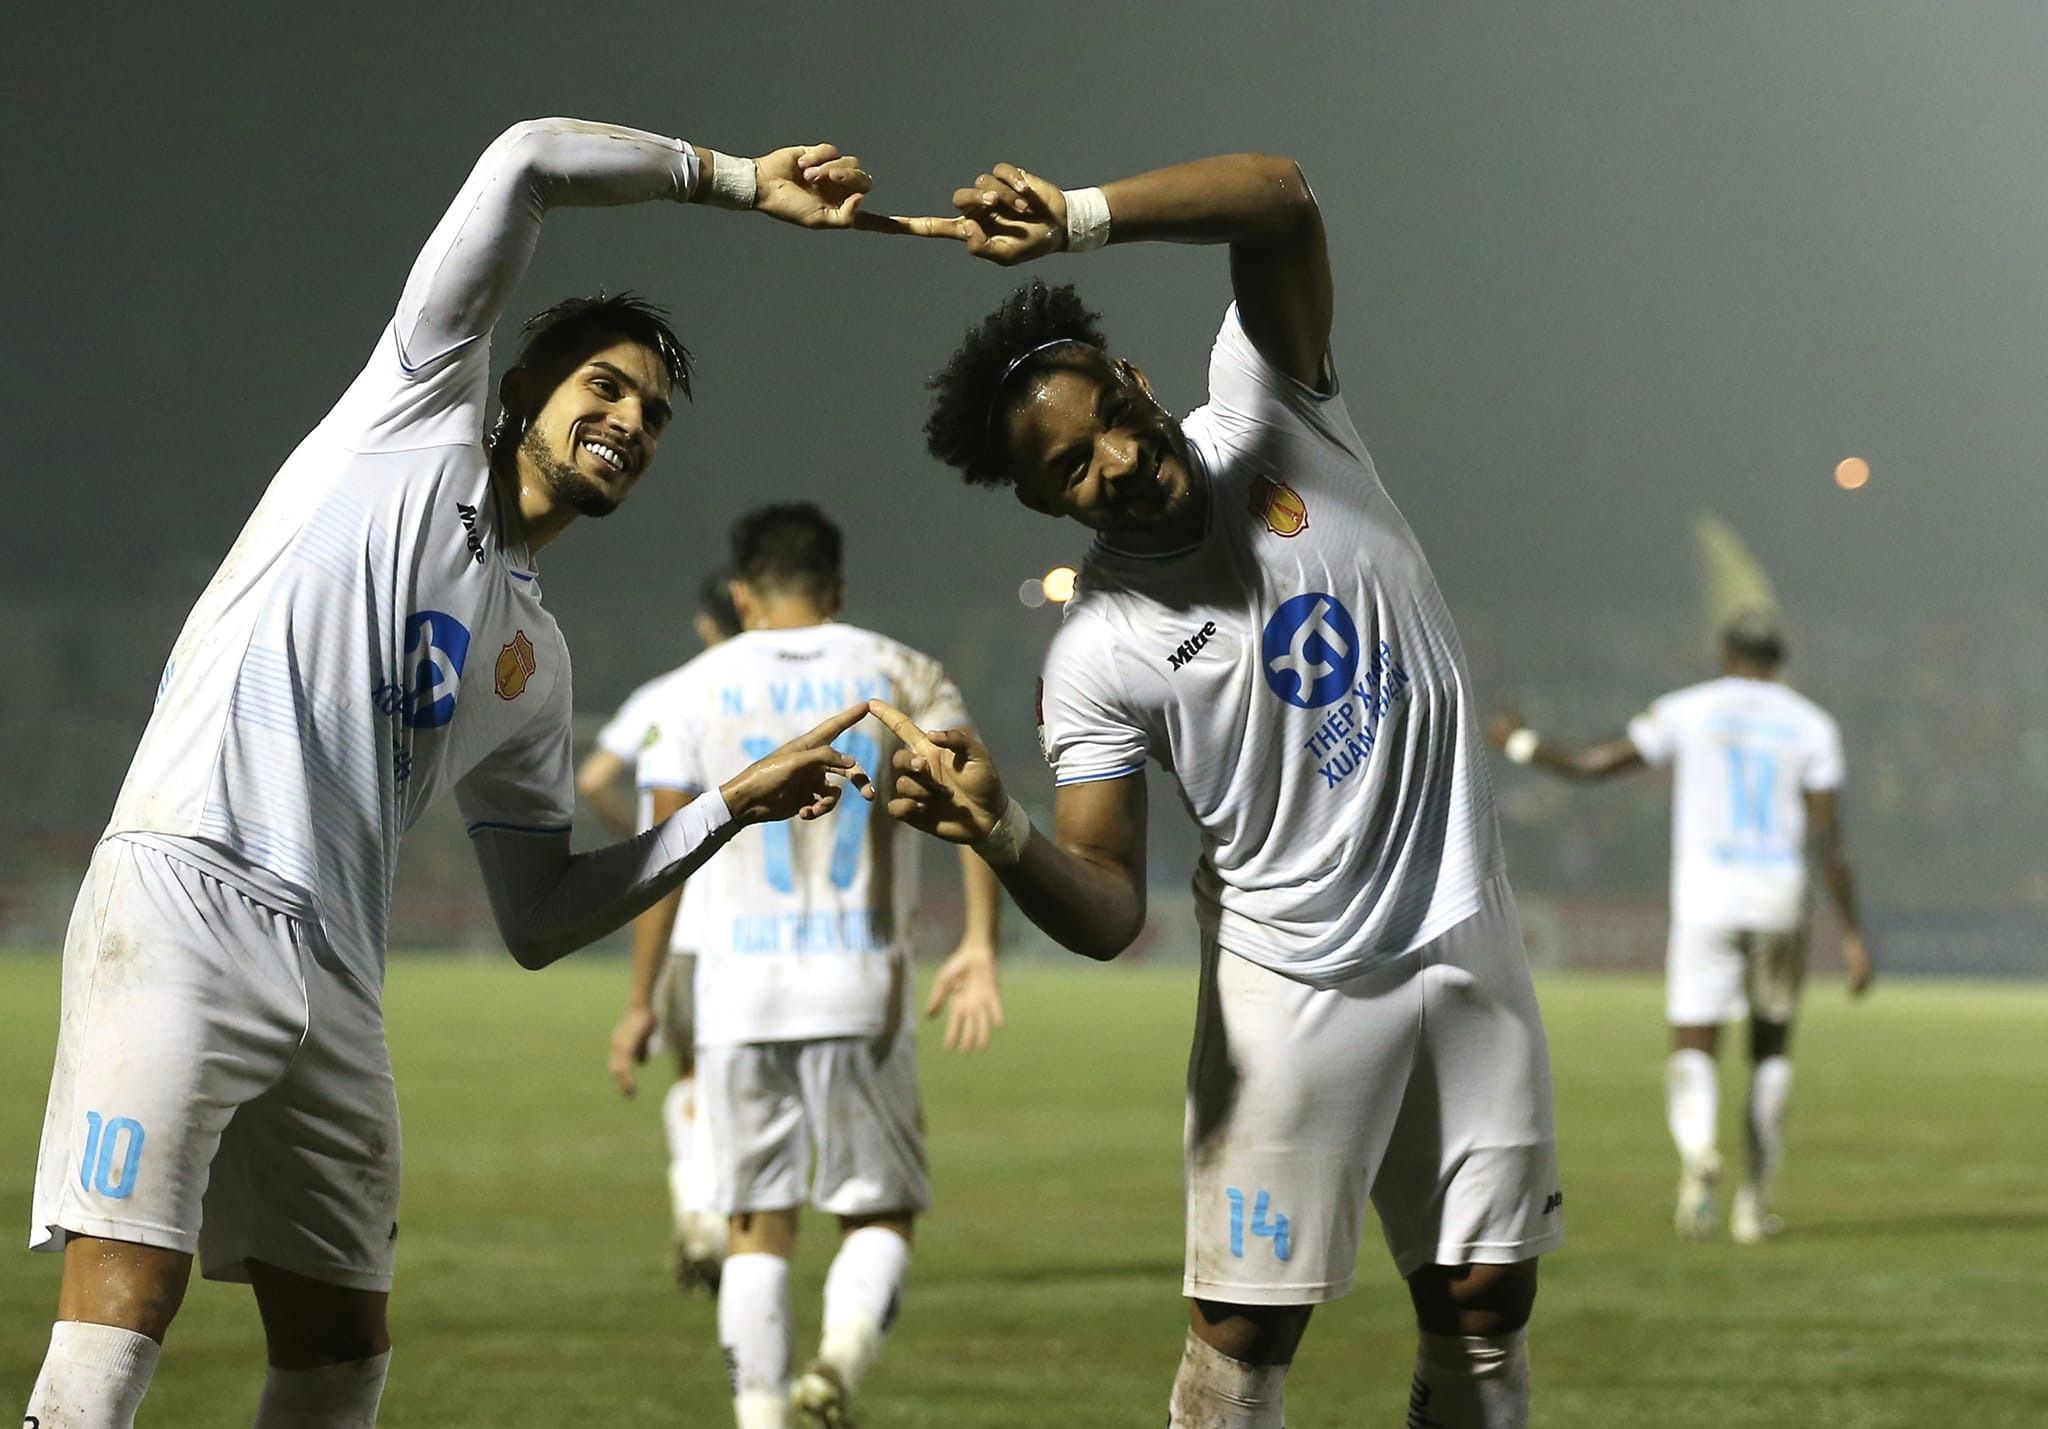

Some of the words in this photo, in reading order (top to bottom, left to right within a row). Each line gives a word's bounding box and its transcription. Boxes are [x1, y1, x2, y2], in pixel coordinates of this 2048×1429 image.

[1167, 621, 1217, 672] Mitre
[1304, 702, 1354, 759] THÉP
[1318, 725, 1375, 789] XUÂN
[80, 1111, 145, 1199] 10
[1226, 1187, 1291, 1262] 14
